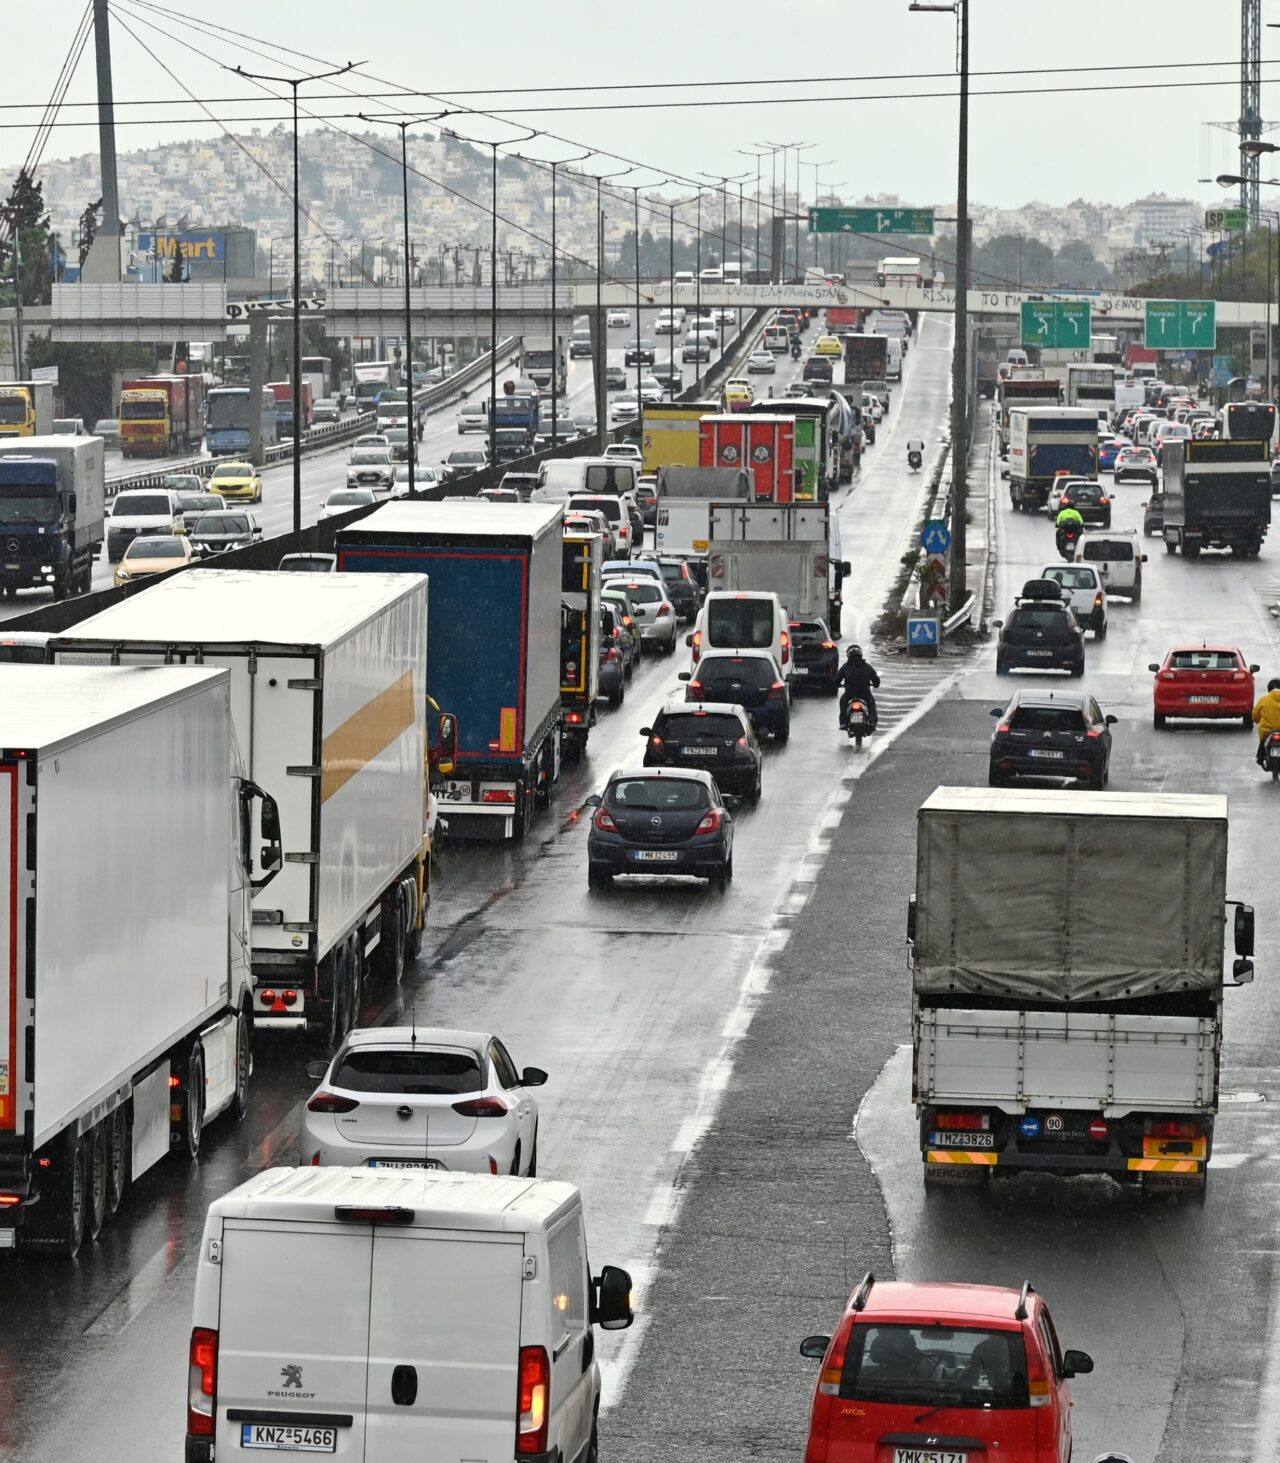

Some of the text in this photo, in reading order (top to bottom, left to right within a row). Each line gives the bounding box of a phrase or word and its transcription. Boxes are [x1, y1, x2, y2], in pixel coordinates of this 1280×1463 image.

[157, 236, 216, 258] Mart
[1046, 1118, 1061, 1130] 90
[1146, 1175, 1202, 1188] MERCEDES
[267, 1390, 317, 1399] PEUGEOT
